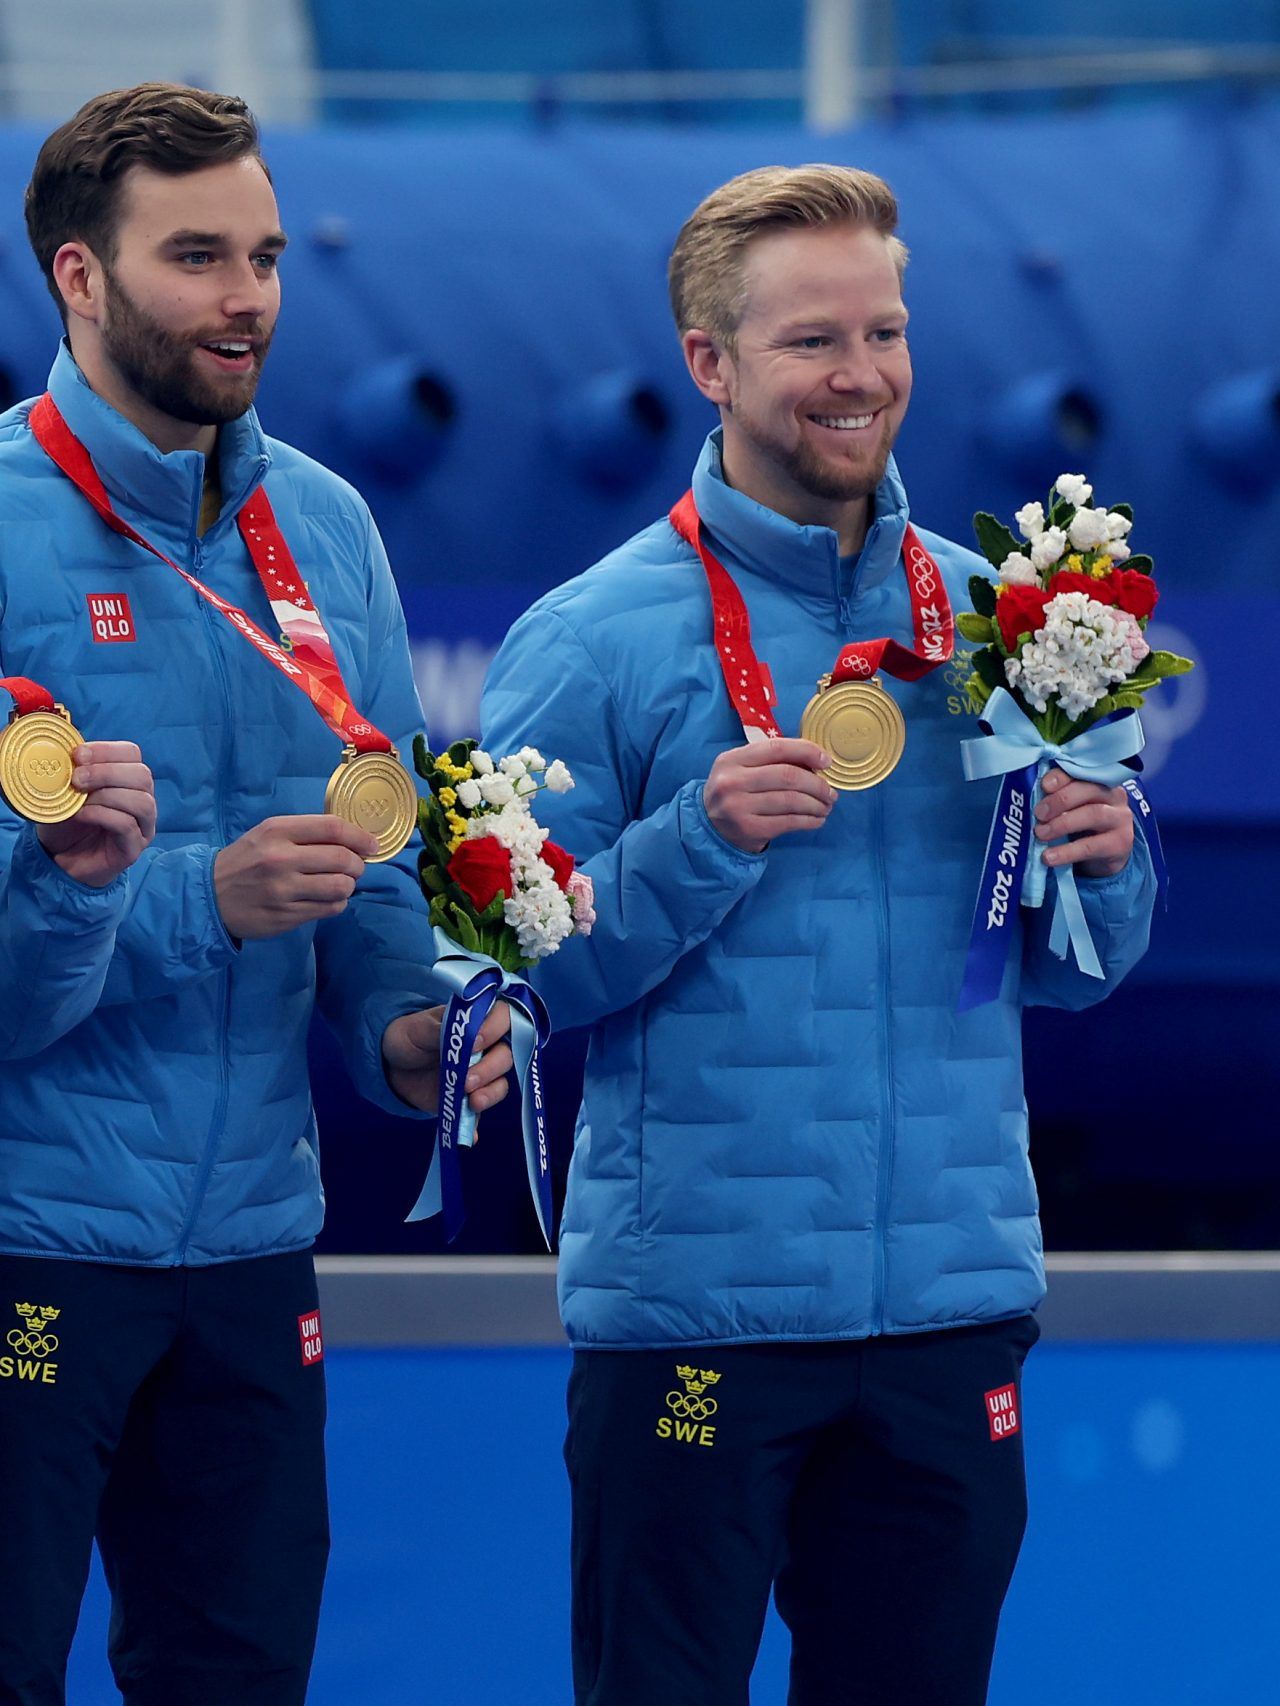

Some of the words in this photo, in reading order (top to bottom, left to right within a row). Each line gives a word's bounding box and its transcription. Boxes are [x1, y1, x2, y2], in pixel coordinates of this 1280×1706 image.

[91, 599, 124, 617] UNI
[95, 619, 130, 640] QLO
[228, 611, 302, 675] BEIJING
[946, 696, 984, 715] SW
[1122, 779, 1151, 818] BEIJ
[998, 788, 1024, 868] BEIJING
[986, 869, 1013, 931] 2022
[447, 1005, 474, 1065] 2022
[441, 1069, 458, 1150] BEIJING
[536, 1116, 548, 1179] 2022
[301, 1316, 319, 1338] UNI
[304, 1336, 322, 1361] QLO
[989, 1390, 1013, 1414] UNI
[655, 1417, 717, 1447] SWE
[993, 1410, 1017, 1436] QLO
